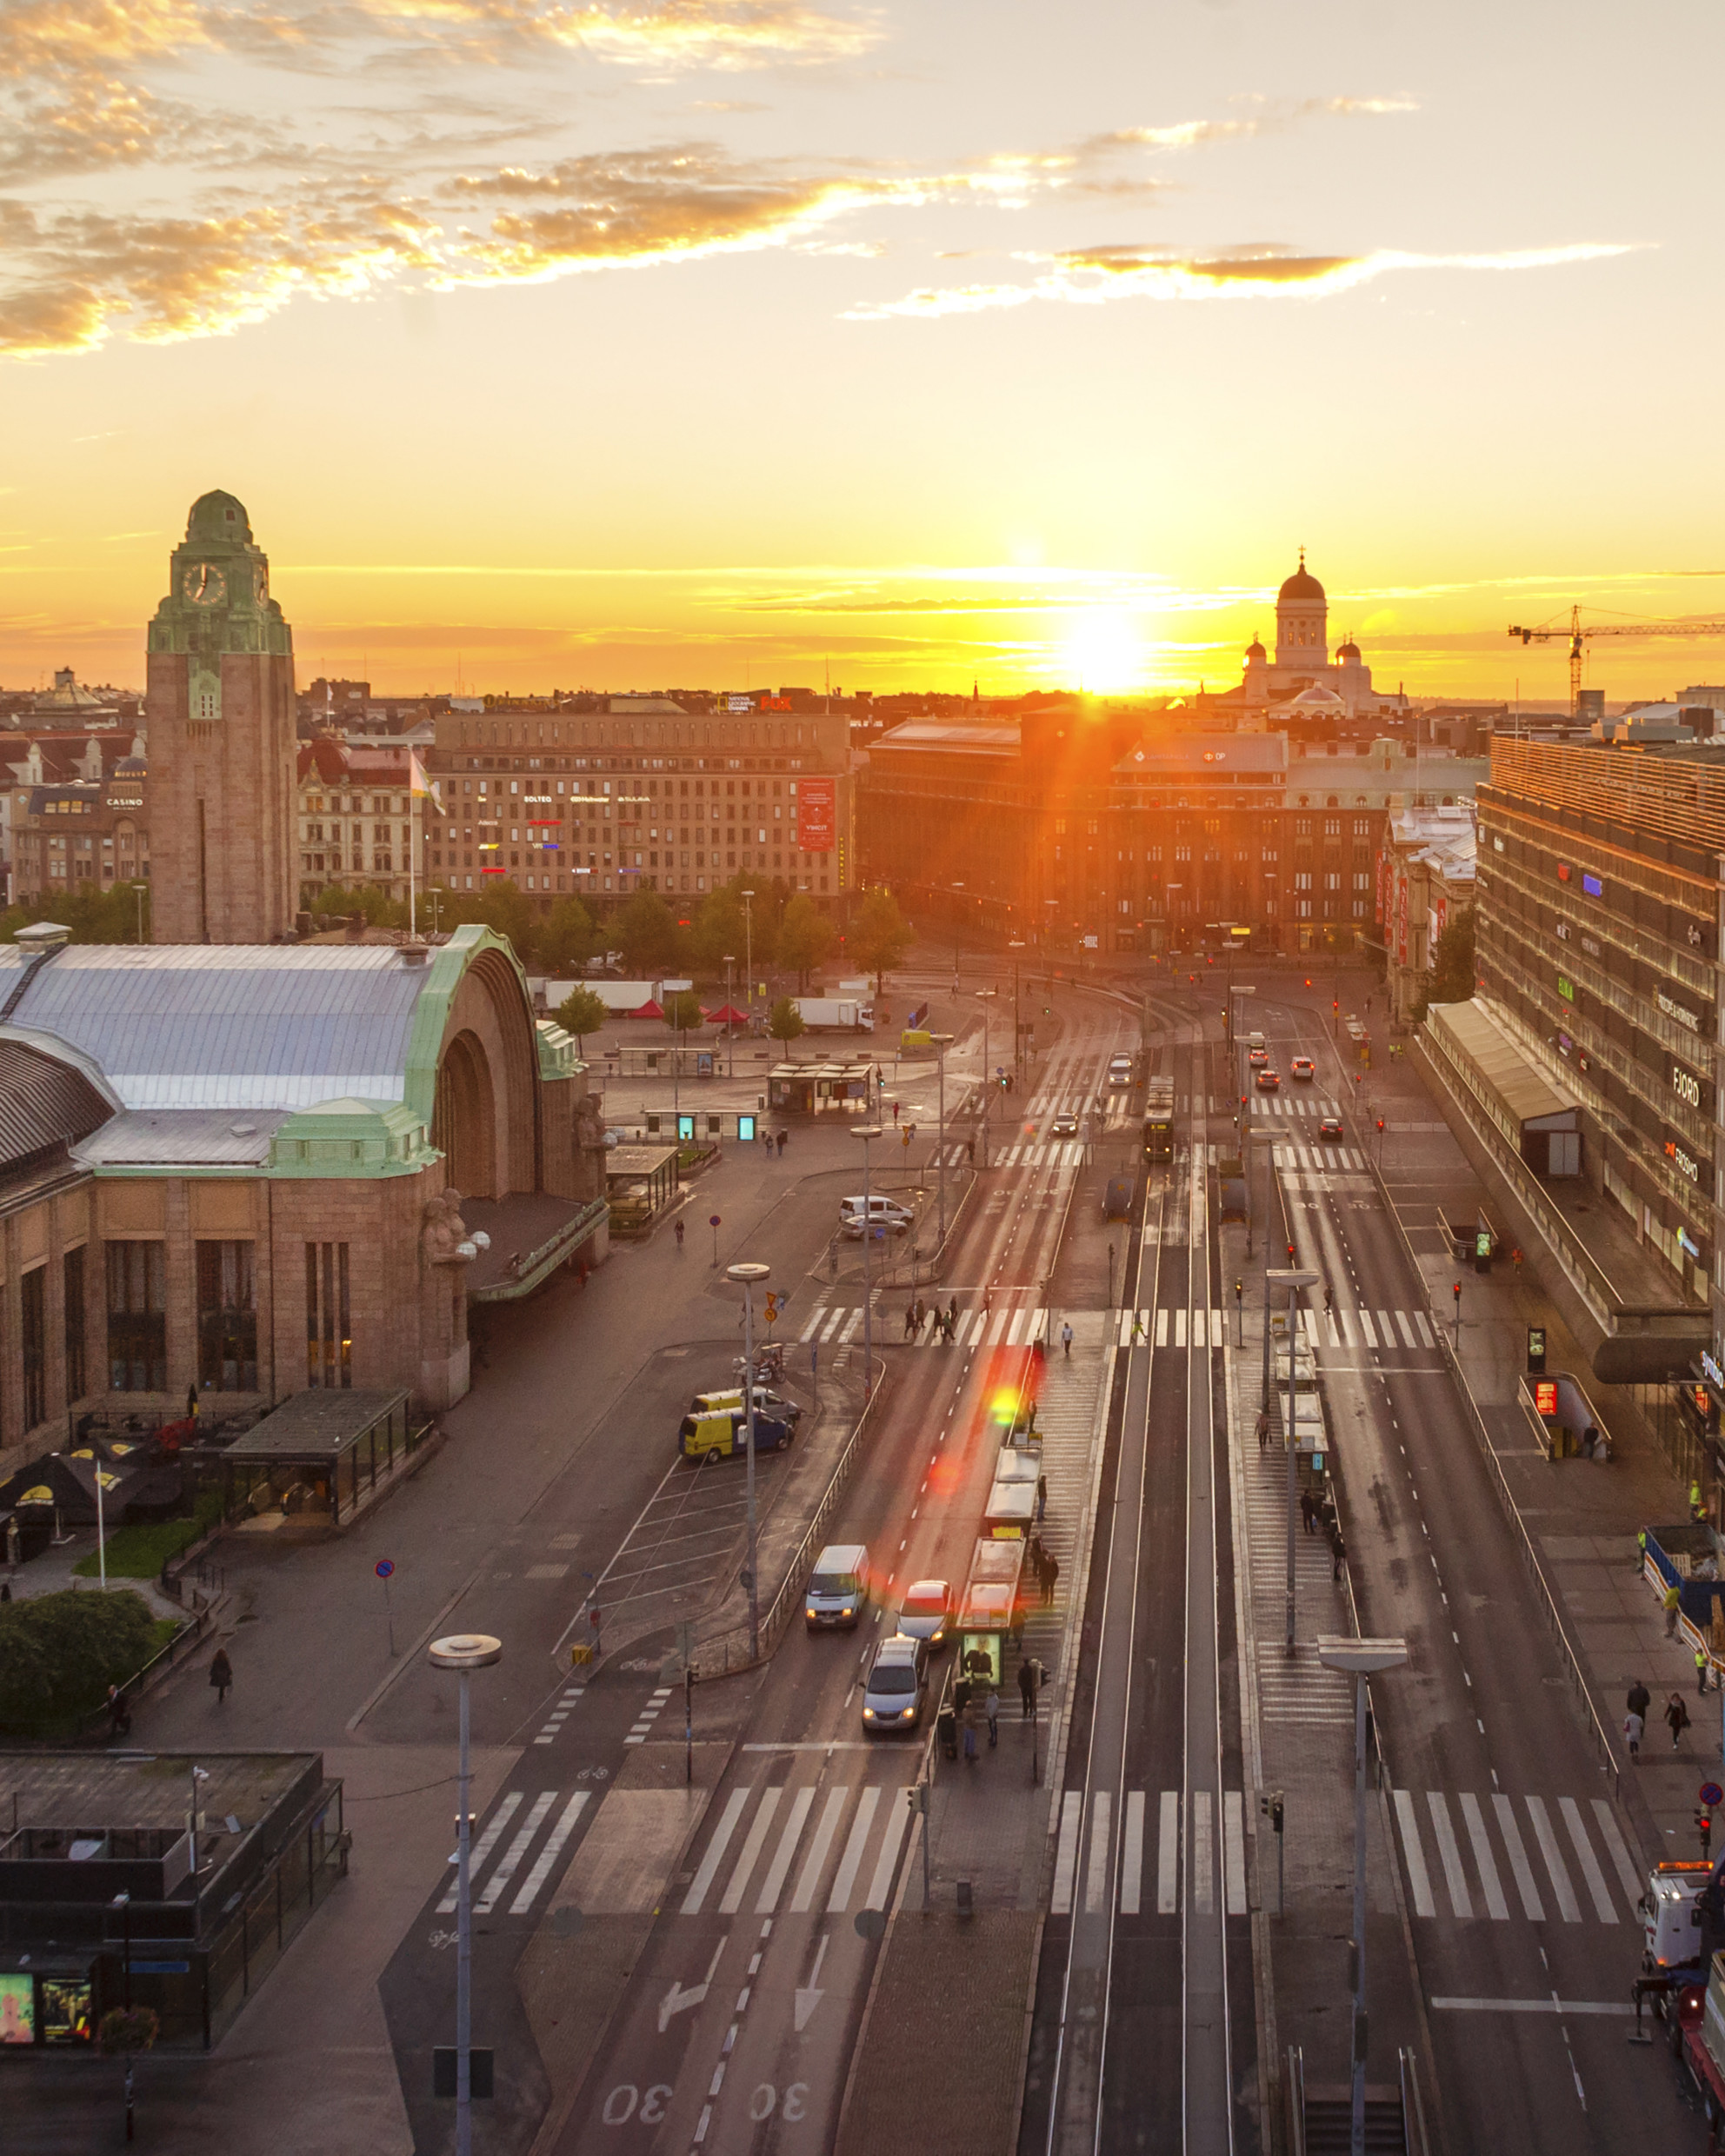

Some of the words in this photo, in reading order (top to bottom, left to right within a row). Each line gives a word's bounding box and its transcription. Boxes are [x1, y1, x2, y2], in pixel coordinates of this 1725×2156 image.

[761, 696, 792, 710] FOX
[1215, 752, 1226, 761] OP
[1674, 1067, 1699, 1107] FJORD
[1675, 1148, 1697, 1182] FROSMO
[603, 2084, 673, 2126] 30
[750, 2082, 810, 2122] 30
